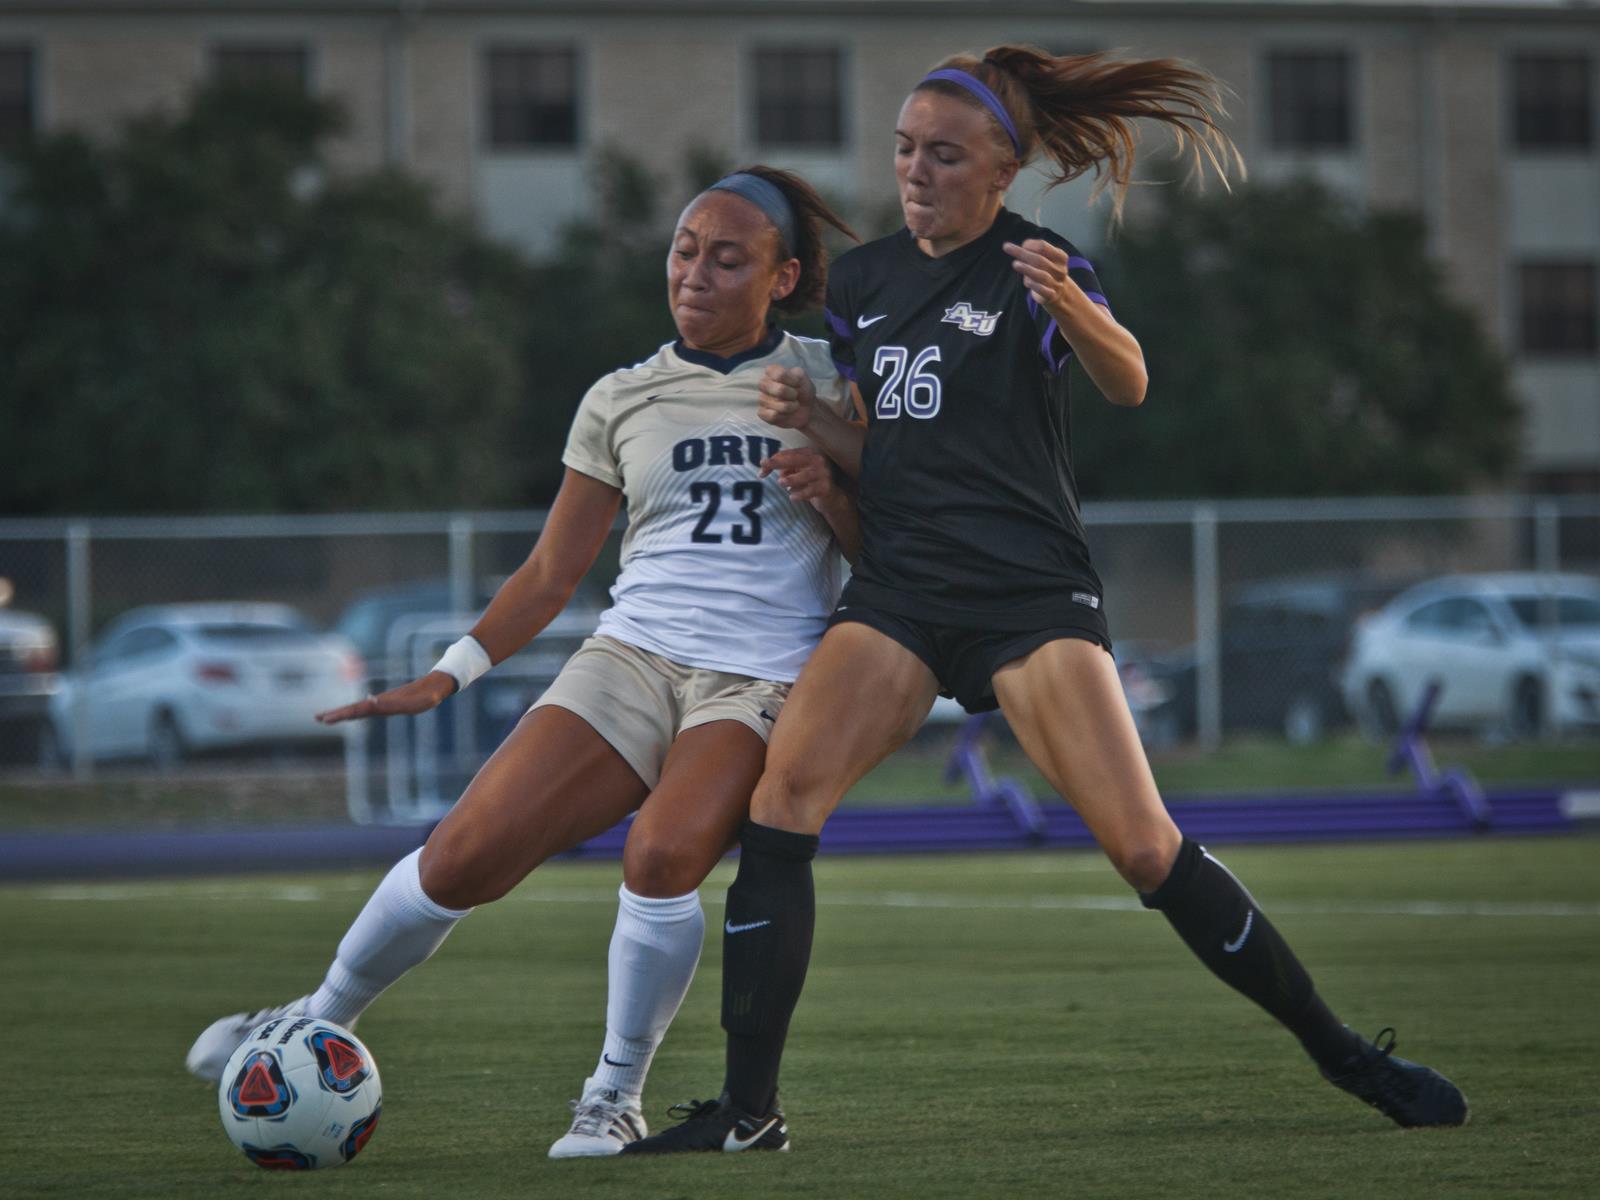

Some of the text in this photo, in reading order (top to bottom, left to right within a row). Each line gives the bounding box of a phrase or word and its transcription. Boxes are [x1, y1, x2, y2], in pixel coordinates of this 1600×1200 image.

[940, 302, 1003, 336] ACU
[872, 345, 942, 419] 26
[673, 435, 782, 472] ORU
[689, 481, 763, 545] 23
